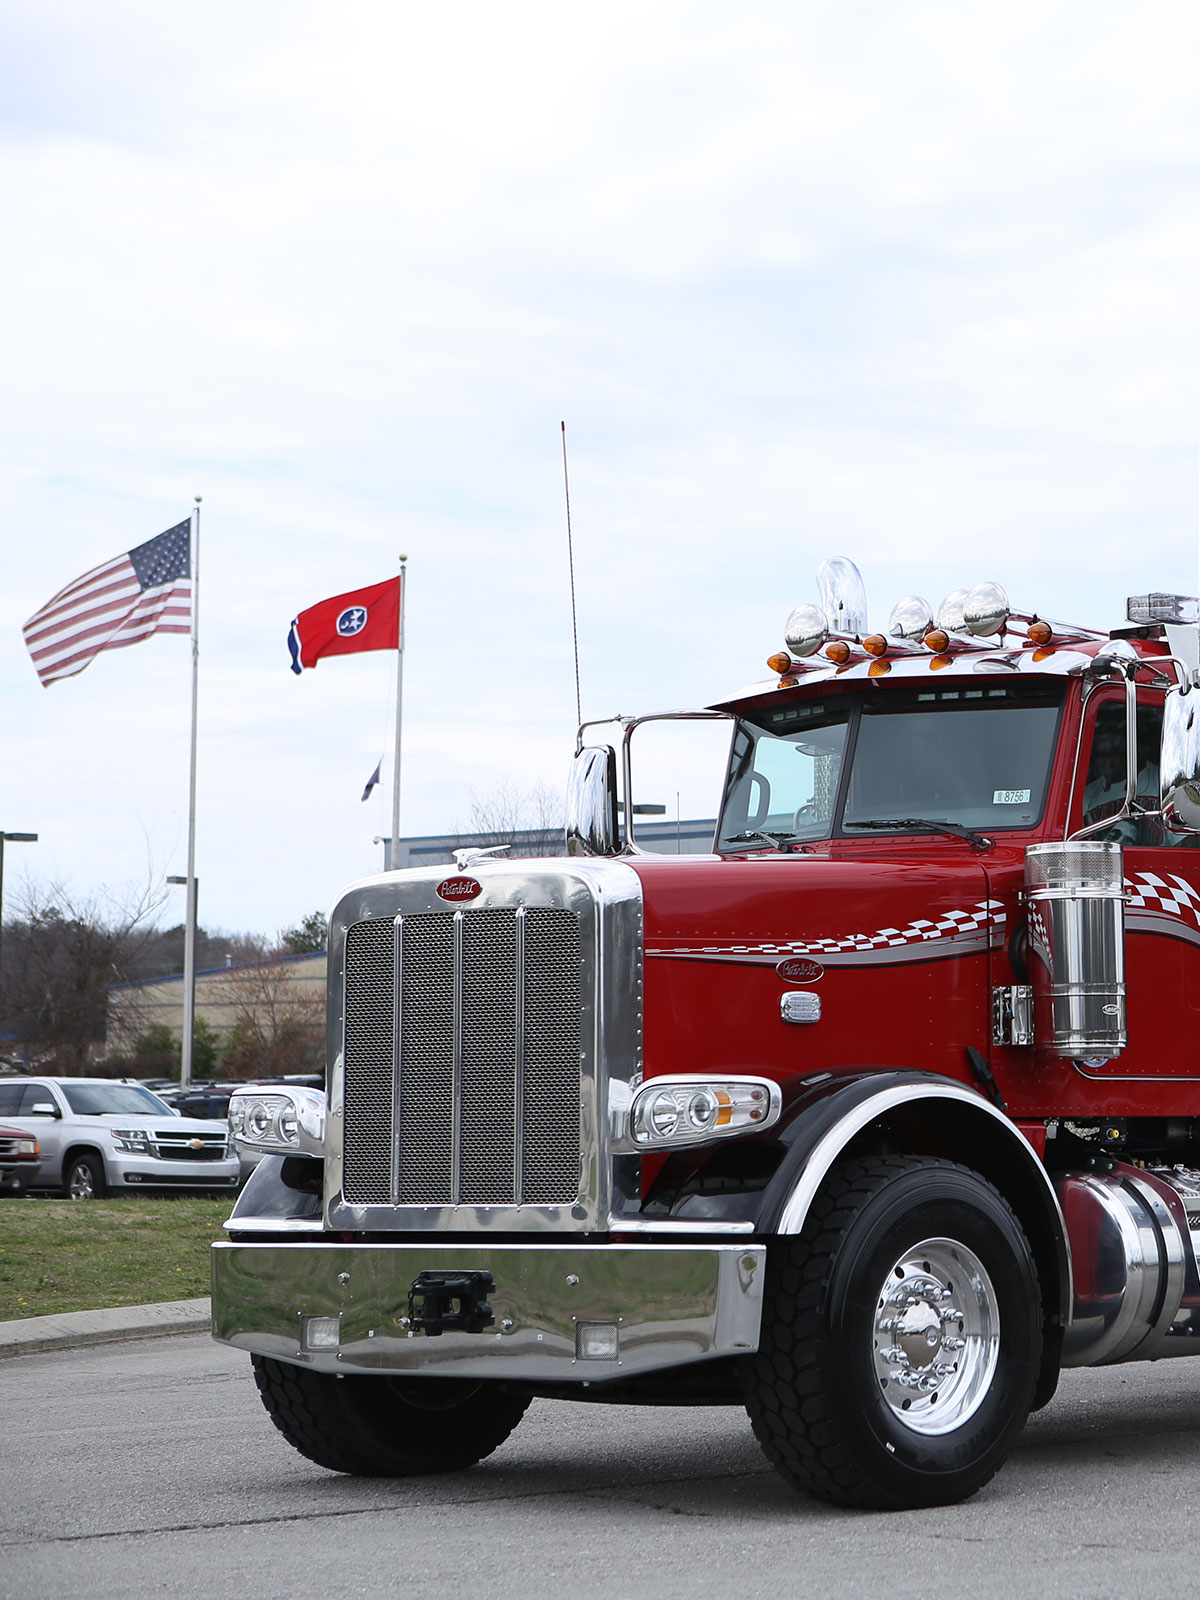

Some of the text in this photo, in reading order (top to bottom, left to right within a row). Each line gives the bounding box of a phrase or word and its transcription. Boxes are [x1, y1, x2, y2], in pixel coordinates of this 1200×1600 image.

[1004, 791, 1024, 803] 8756
[441, 881, 478, 897] Peterbilt
[782, 961, 820, 977] Peterbilt
